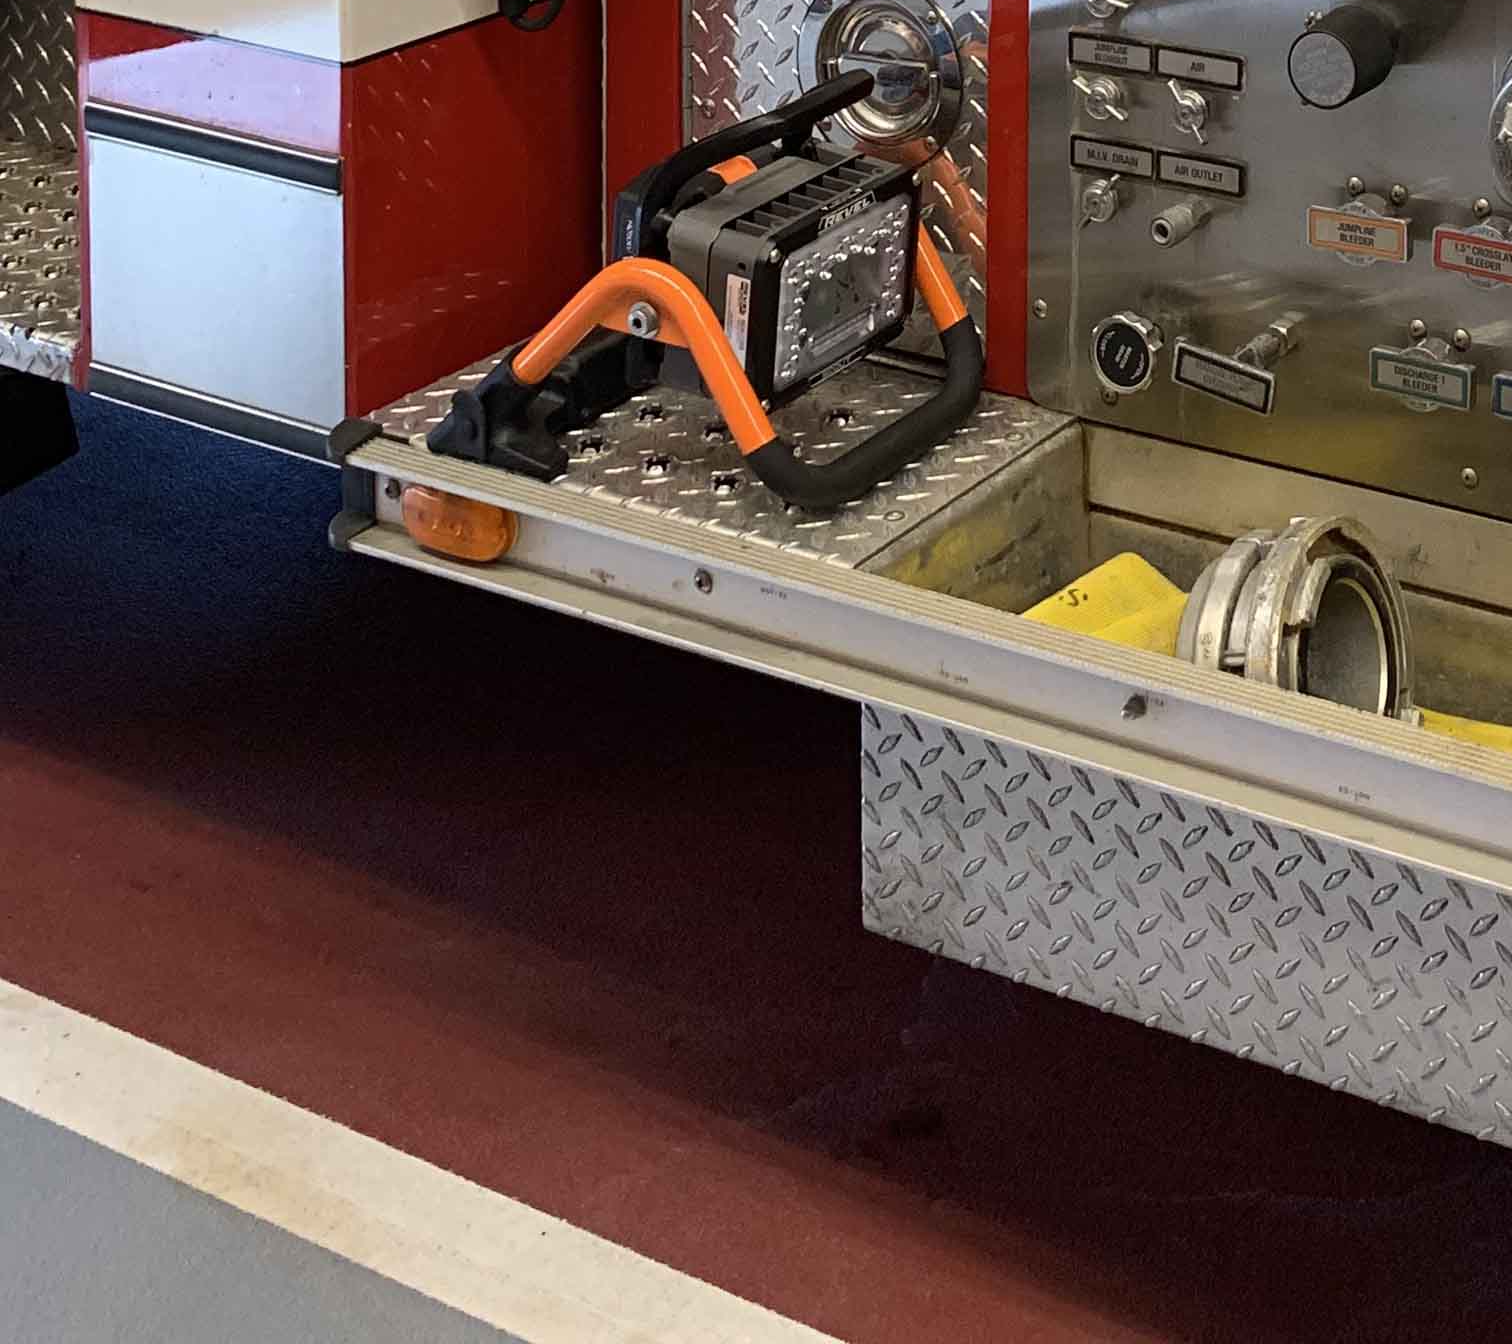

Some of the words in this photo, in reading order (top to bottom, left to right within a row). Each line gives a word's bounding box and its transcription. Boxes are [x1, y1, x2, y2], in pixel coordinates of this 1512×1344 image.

[1190, 62, 1204, 72] AIR
[1113, 153, 1138, 166] DRAIN
[1175, 165, 1189, 176] AIR
[1191, 167, 1223, 183] OUTLET
[1339, 233, 1374, 247] BLEEDER
[1465, 256, 1501, 271] BLEEDER
[1394, 365, 1438, 381] DISCHARGE
[1402, 377, 1438, 394] BLEEDER
